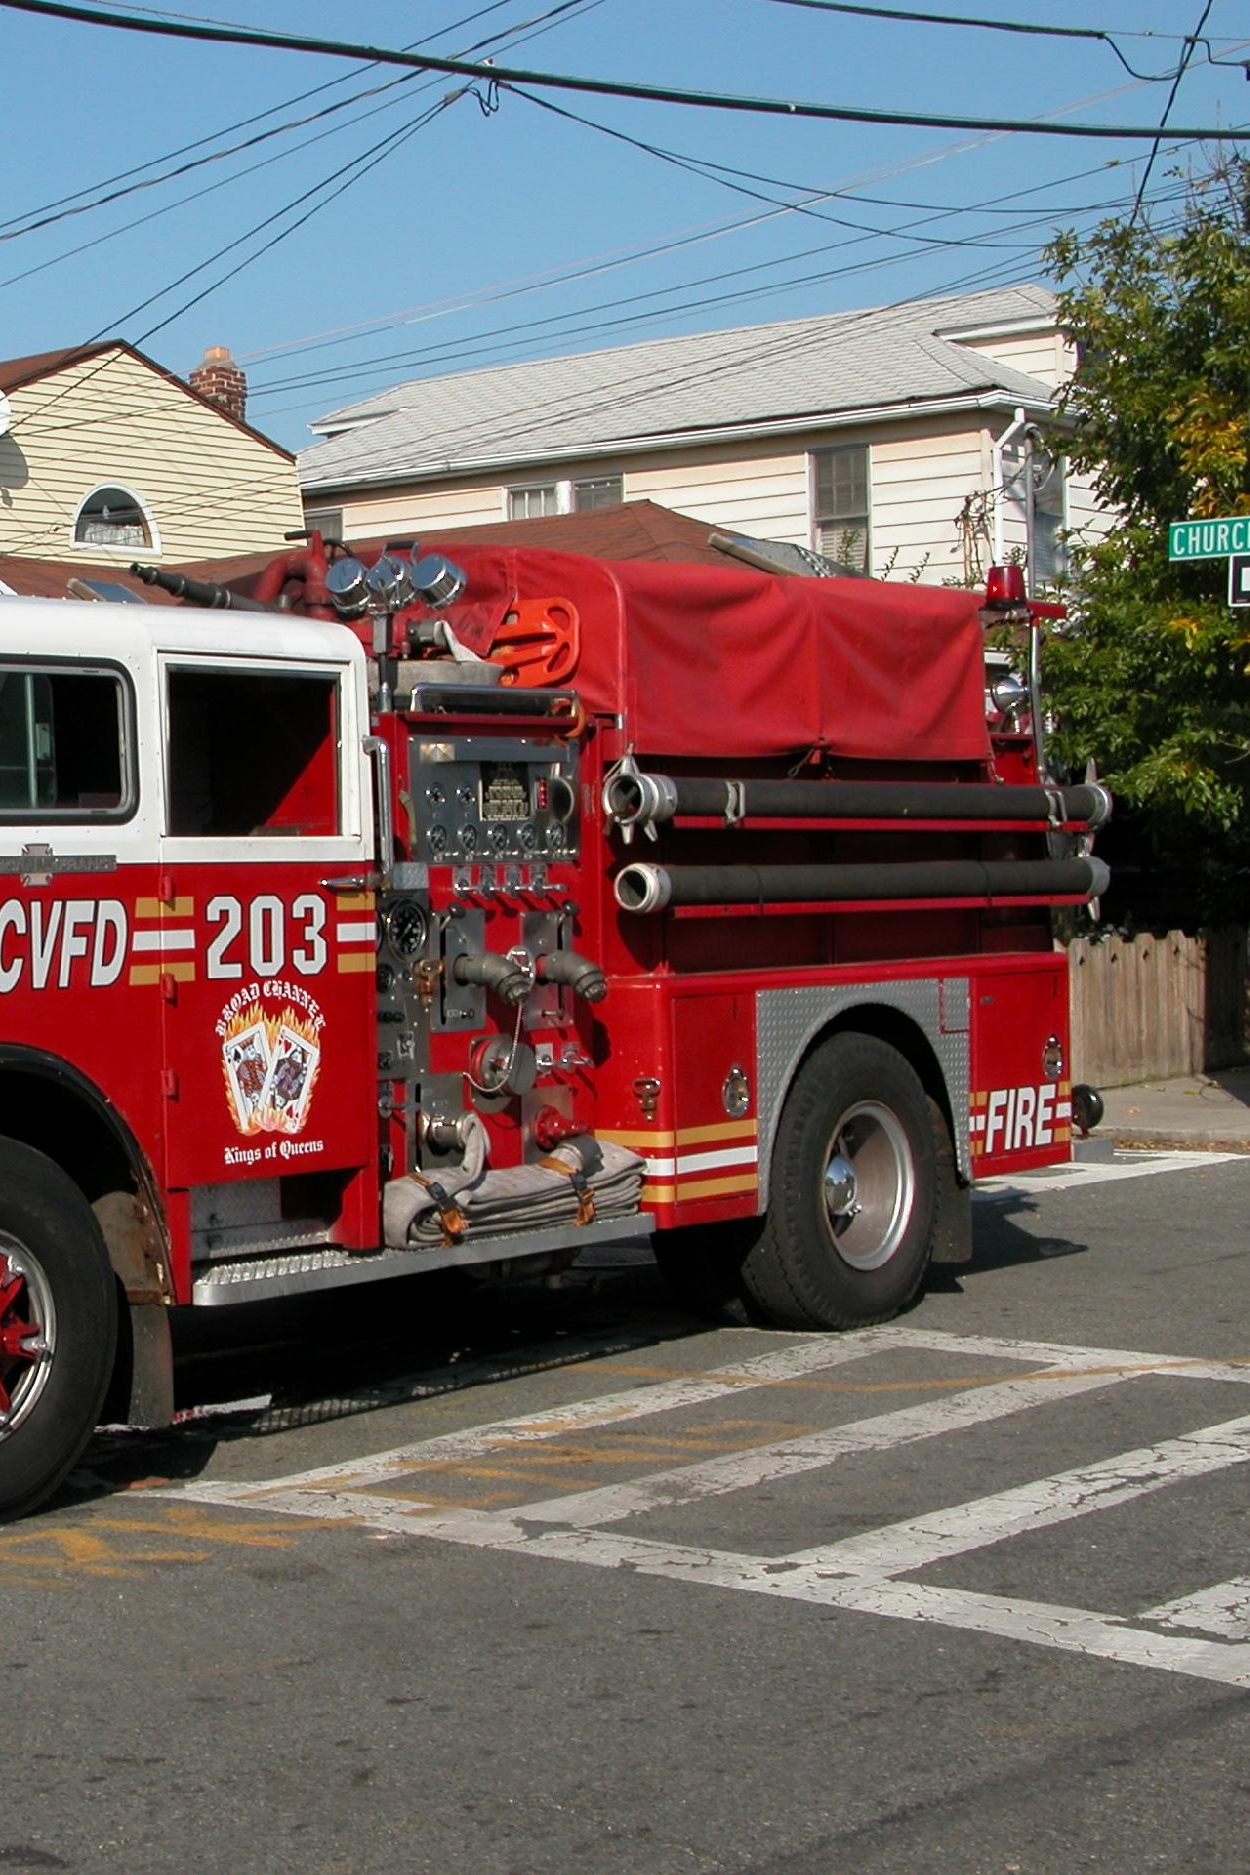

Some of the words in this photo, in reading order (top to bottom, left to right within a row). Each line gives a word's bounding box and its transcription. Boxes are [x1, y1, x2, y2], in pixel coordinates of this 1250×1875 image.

[1173, 521, 1250, 555] CHURC
[206, 893, 327, 980] 203
[984, 1083, 1057, 1154] FIRE
[224, 1146, 261, 1165] Kings
[265, 1141, 277, 1159] of
[279, 1140, 324, 1159] Queens
